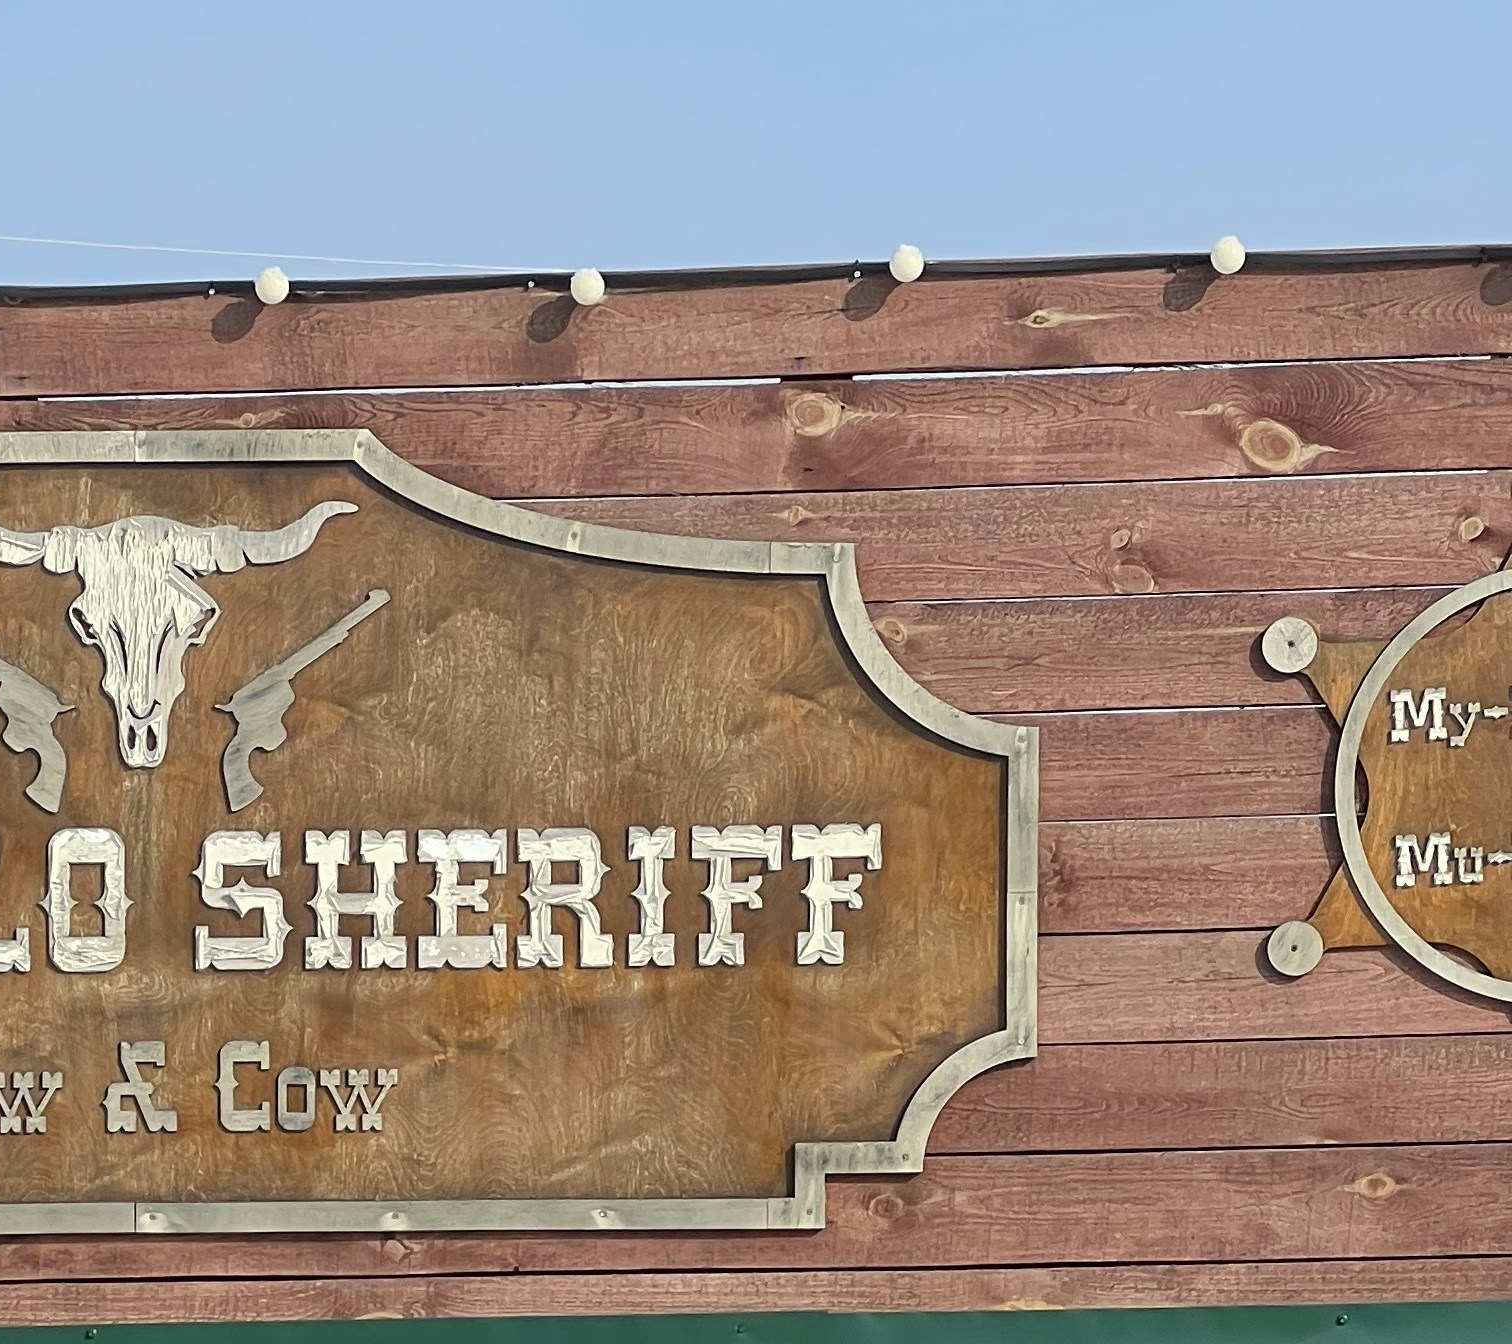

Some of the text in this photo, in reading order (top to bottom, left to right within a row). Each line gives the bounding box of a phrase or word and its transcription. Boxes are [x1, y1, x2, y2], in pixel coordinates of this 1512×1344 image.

[192, 823, 883, 971] SHERIFF
[101, 1040, 178, 1132] &
[215, 1040, 398, 1131] Cow
